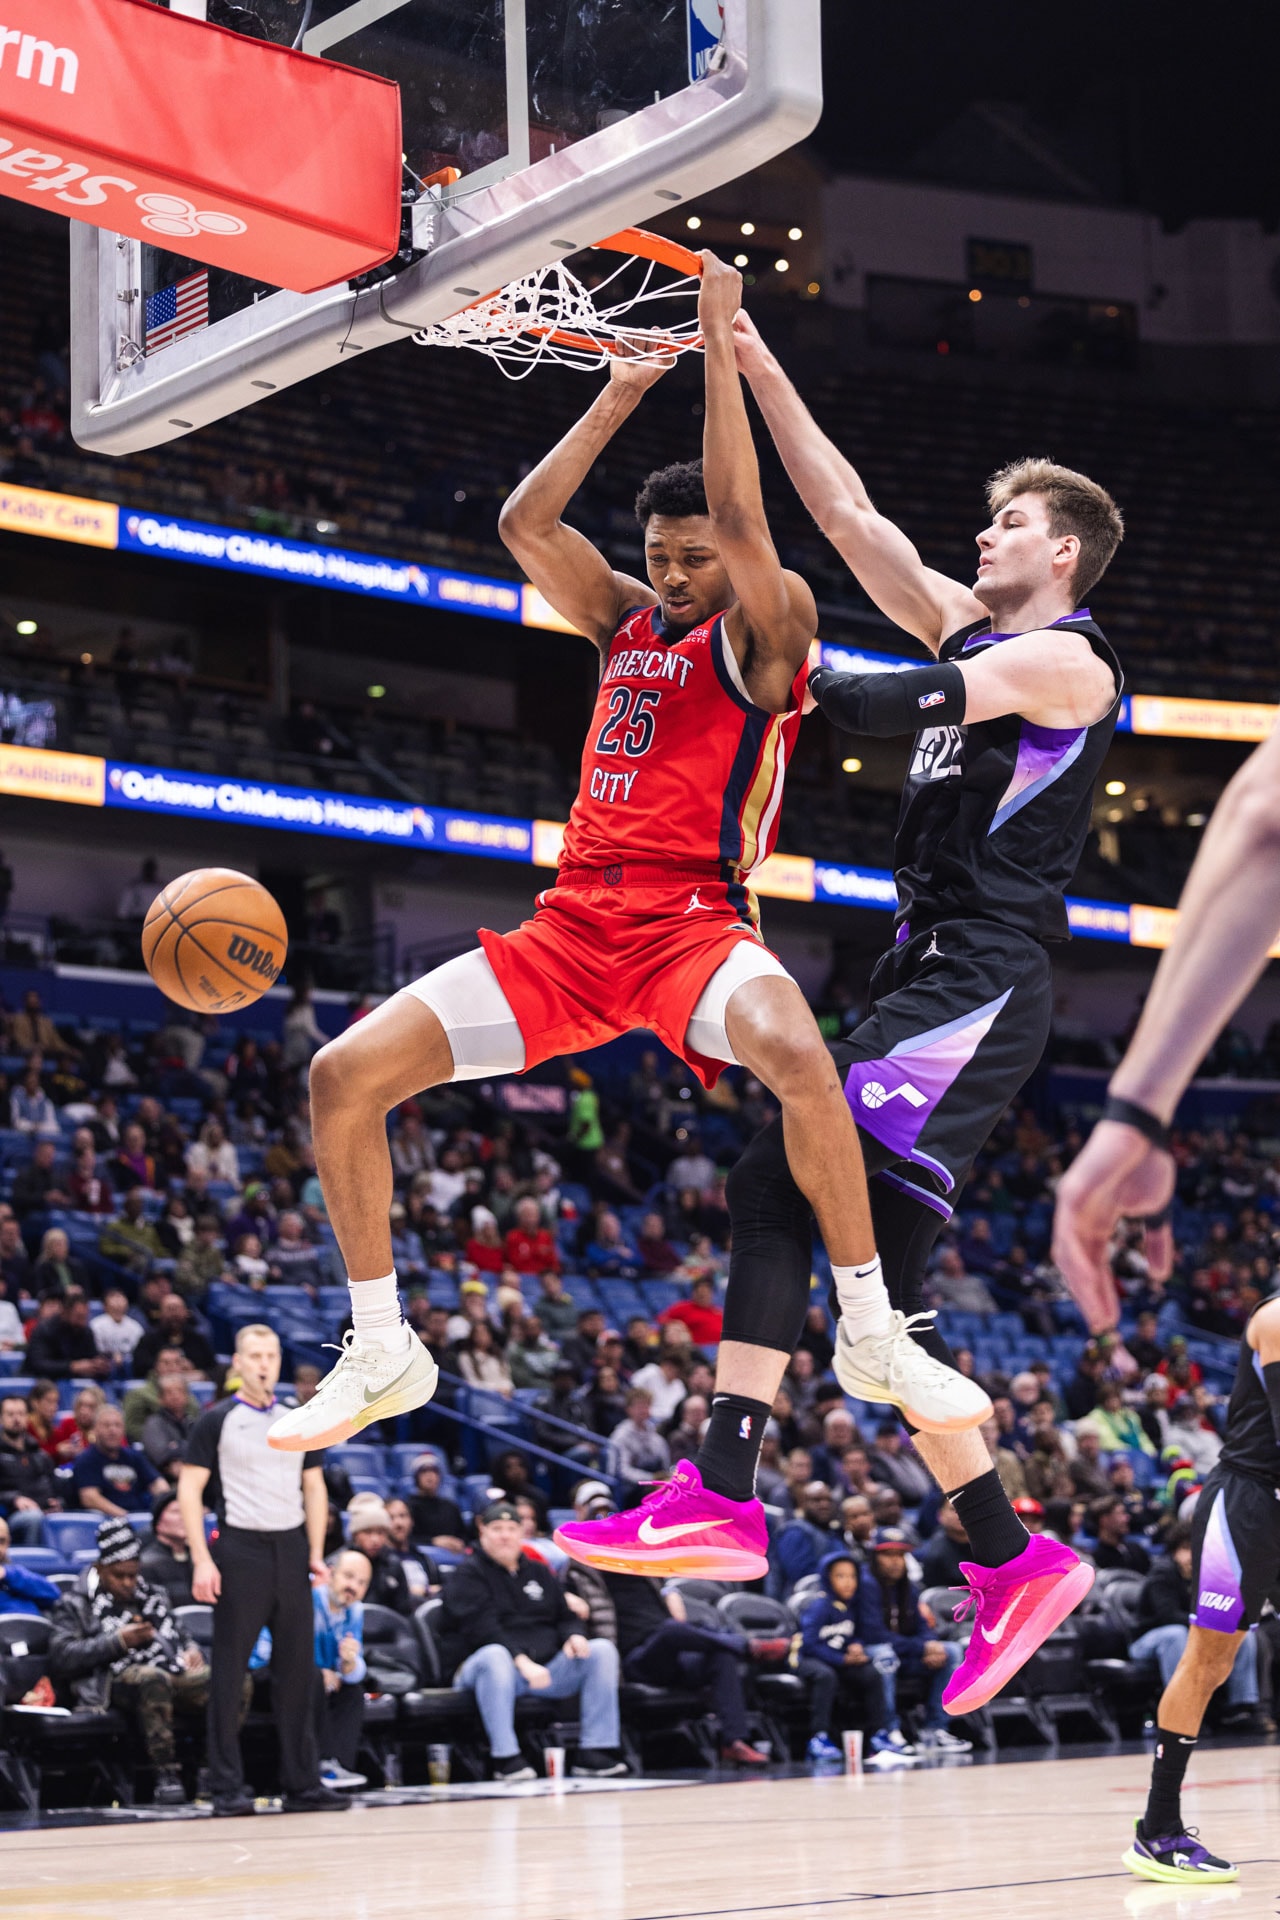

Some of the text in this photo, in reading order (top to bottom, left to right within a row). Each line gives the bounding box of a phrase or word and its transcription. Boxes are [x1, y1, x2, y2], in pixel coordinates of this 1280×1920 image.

[595, 686, 661, 758] 25
[590, 768, 639, 804] CITY
[1199, 1590, 1237, 1613] UTAH
